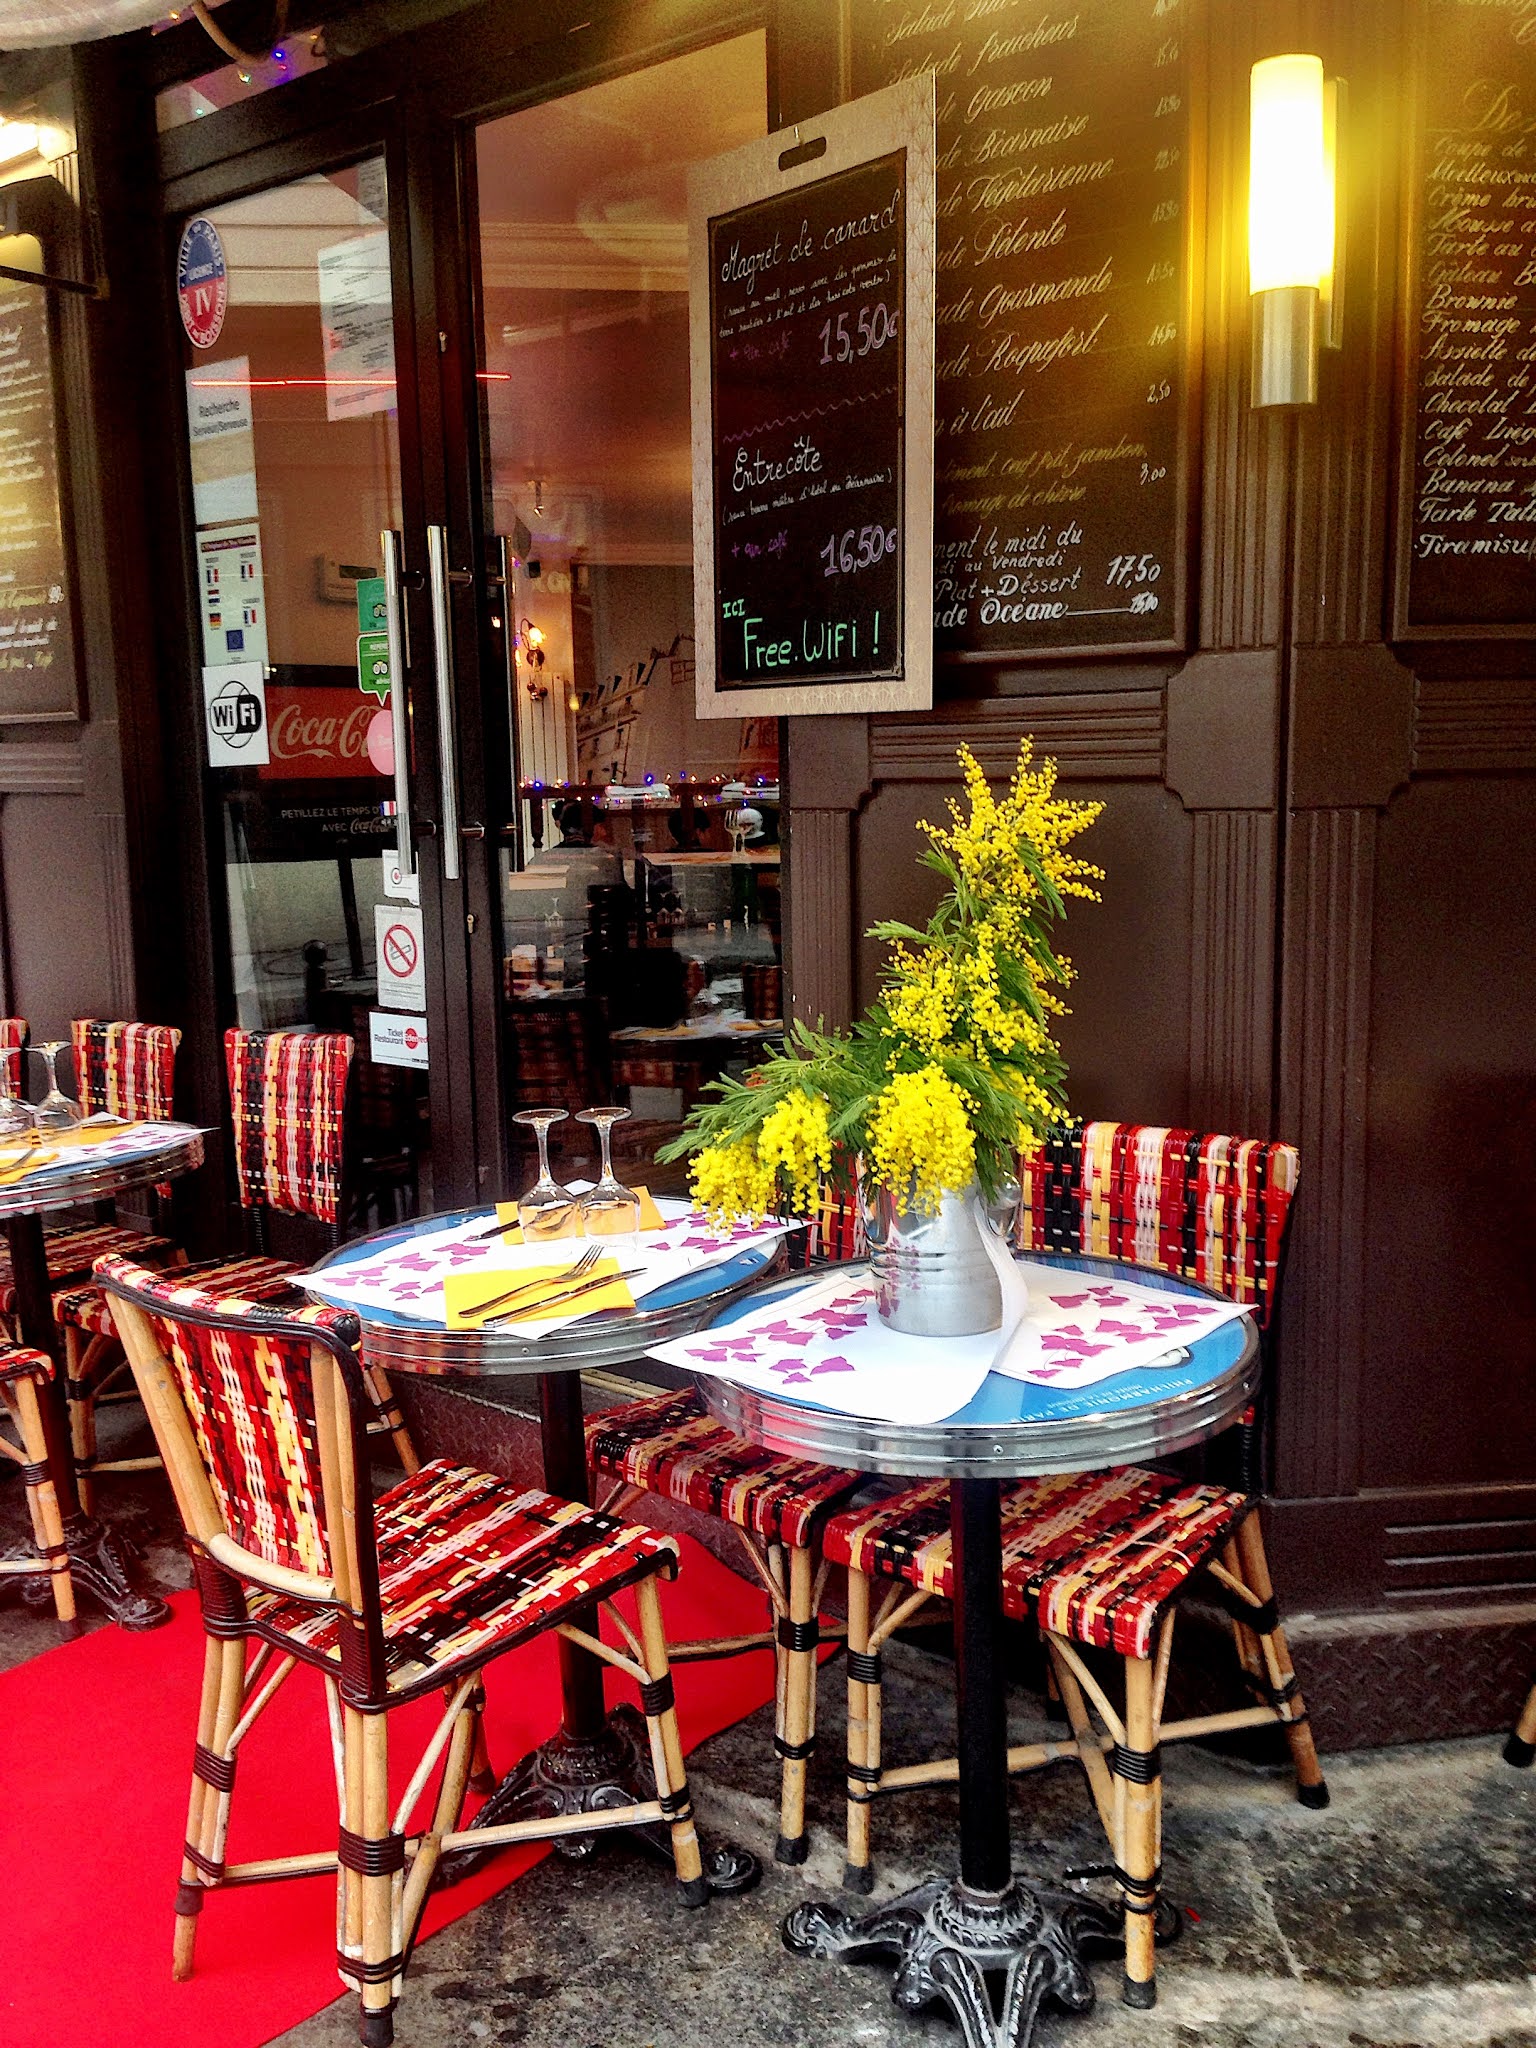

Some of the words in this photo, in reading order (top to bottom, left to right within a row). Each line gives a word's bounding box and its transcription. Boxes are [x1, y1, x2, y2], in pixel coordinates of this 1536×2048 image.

[787, 219, 813, 263] de
[820, 188, 901, 251] canard
[1426, 283, 1519, 311] Brownie
[1421, 468, 1516, 495] Banana
[820, 523, 898, 578] 16,50€
[934, 525, 982, 559] ment
[983, 526, 999, 557] le
[1004, 524, 1051, 553] midi
[1056, 520, 1083, 546] du
[964, 561, 983, 573] au
[991, 549, 1067, 570] Vendredi
[1106, 553, 1162, 589] 17,50
[722, 598, 746, 619] ICI
[321, 823, 348, 832] AVEC
